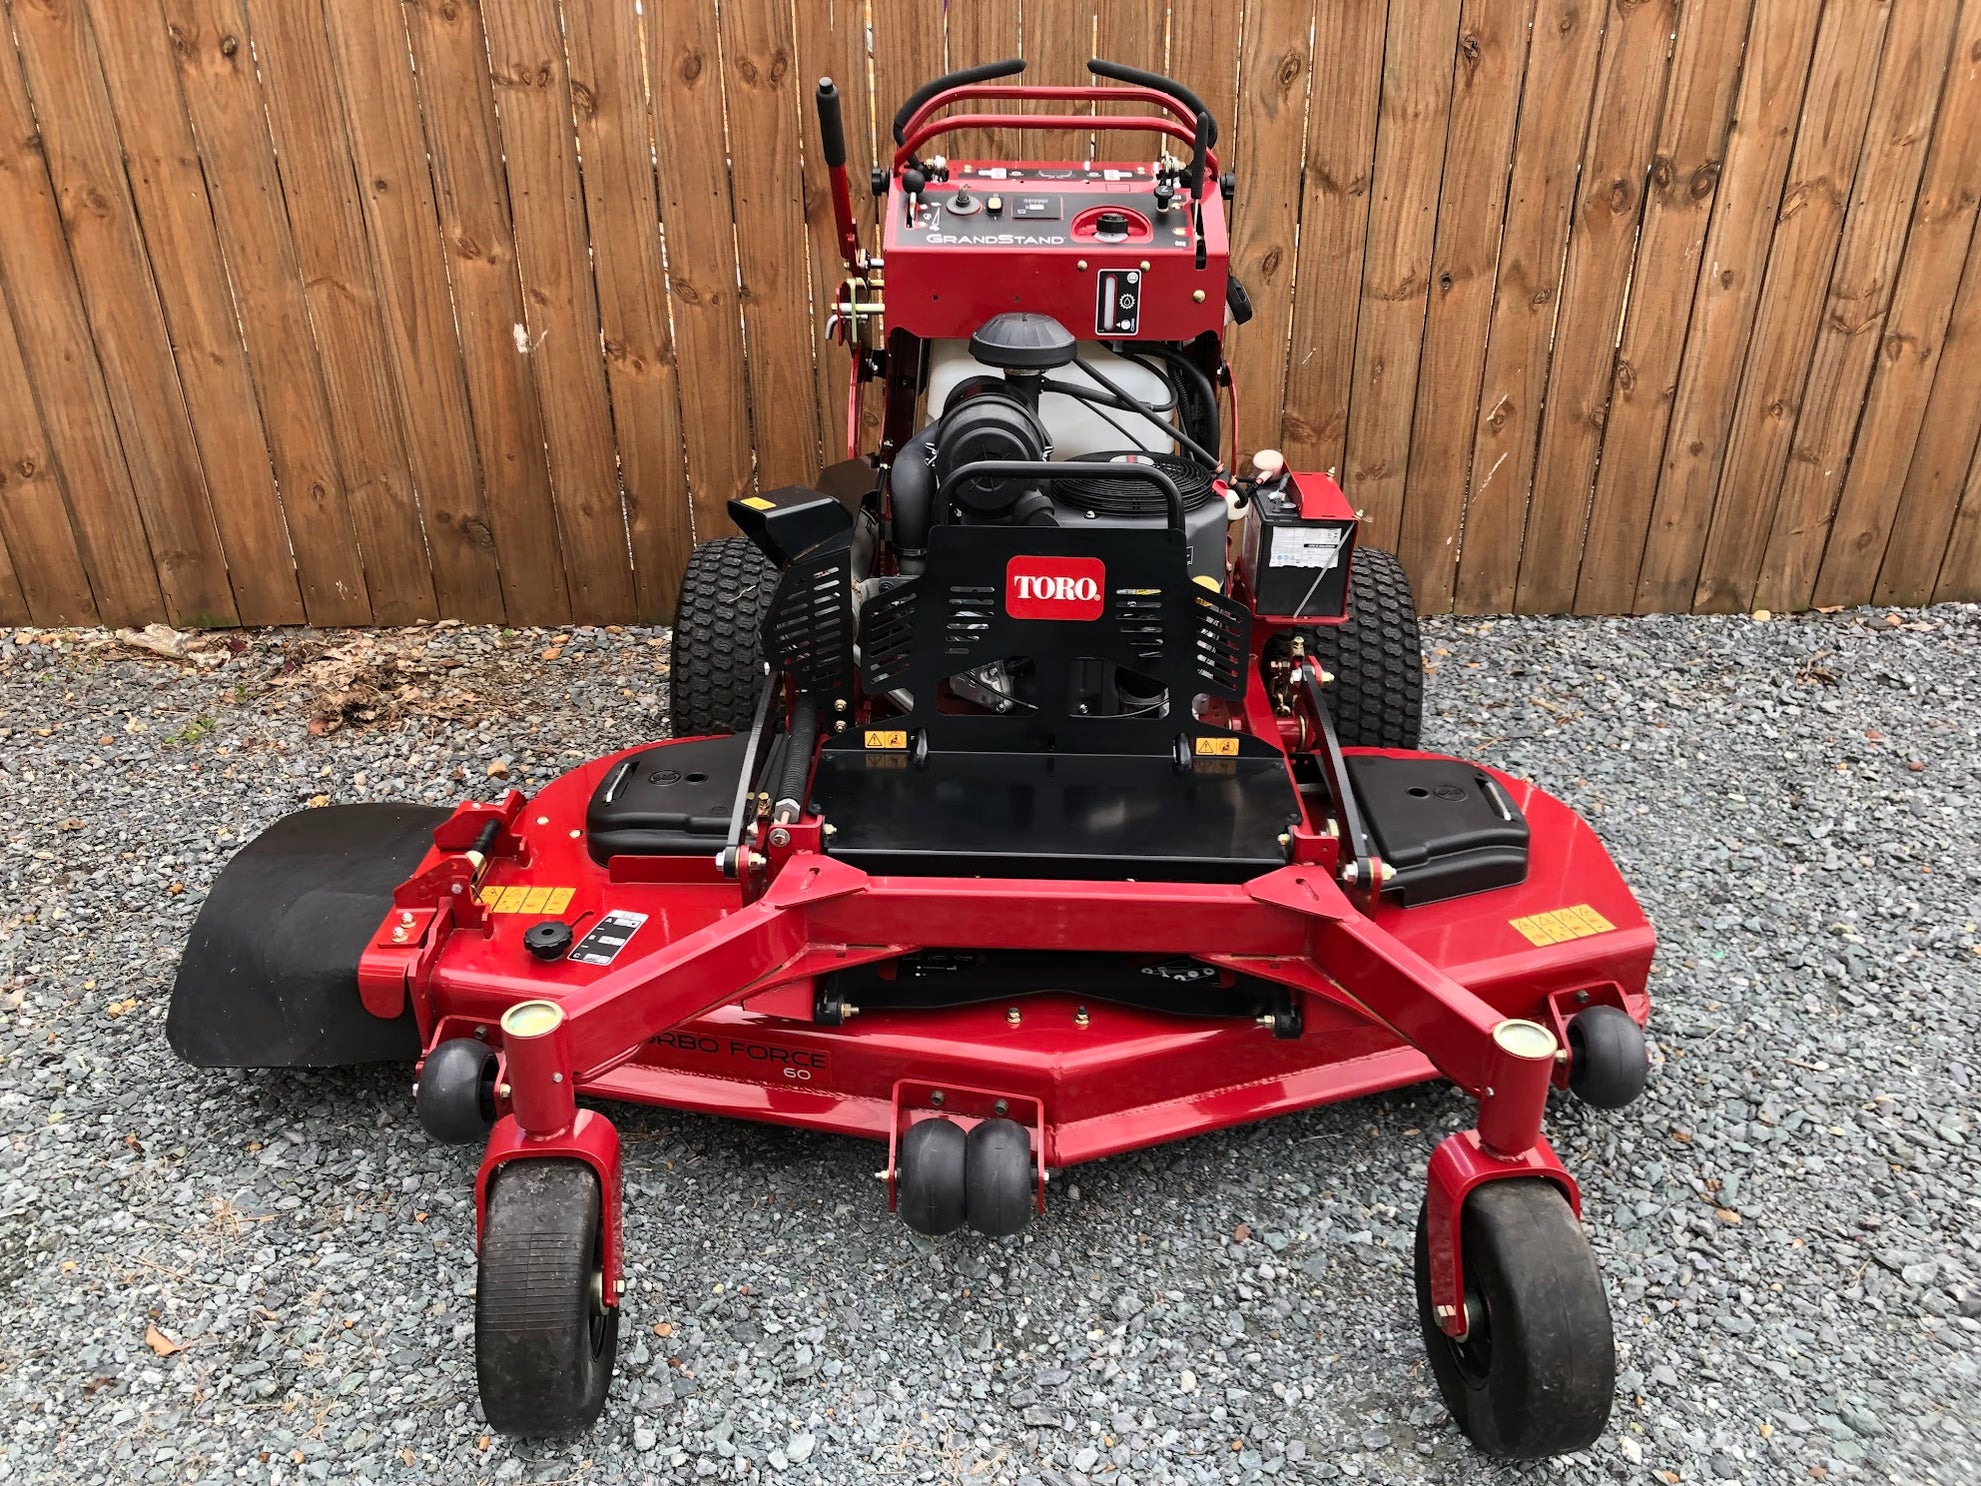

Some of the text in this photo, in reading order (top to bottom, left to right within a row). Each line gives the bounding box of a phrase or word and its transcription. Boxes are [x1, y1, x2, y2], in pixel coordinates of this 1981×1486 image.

[1013, 575, 1098, 601] TORO
[730, 1041, 826, 1069] FORCE
[783, 1067, 811, 1080] 60
